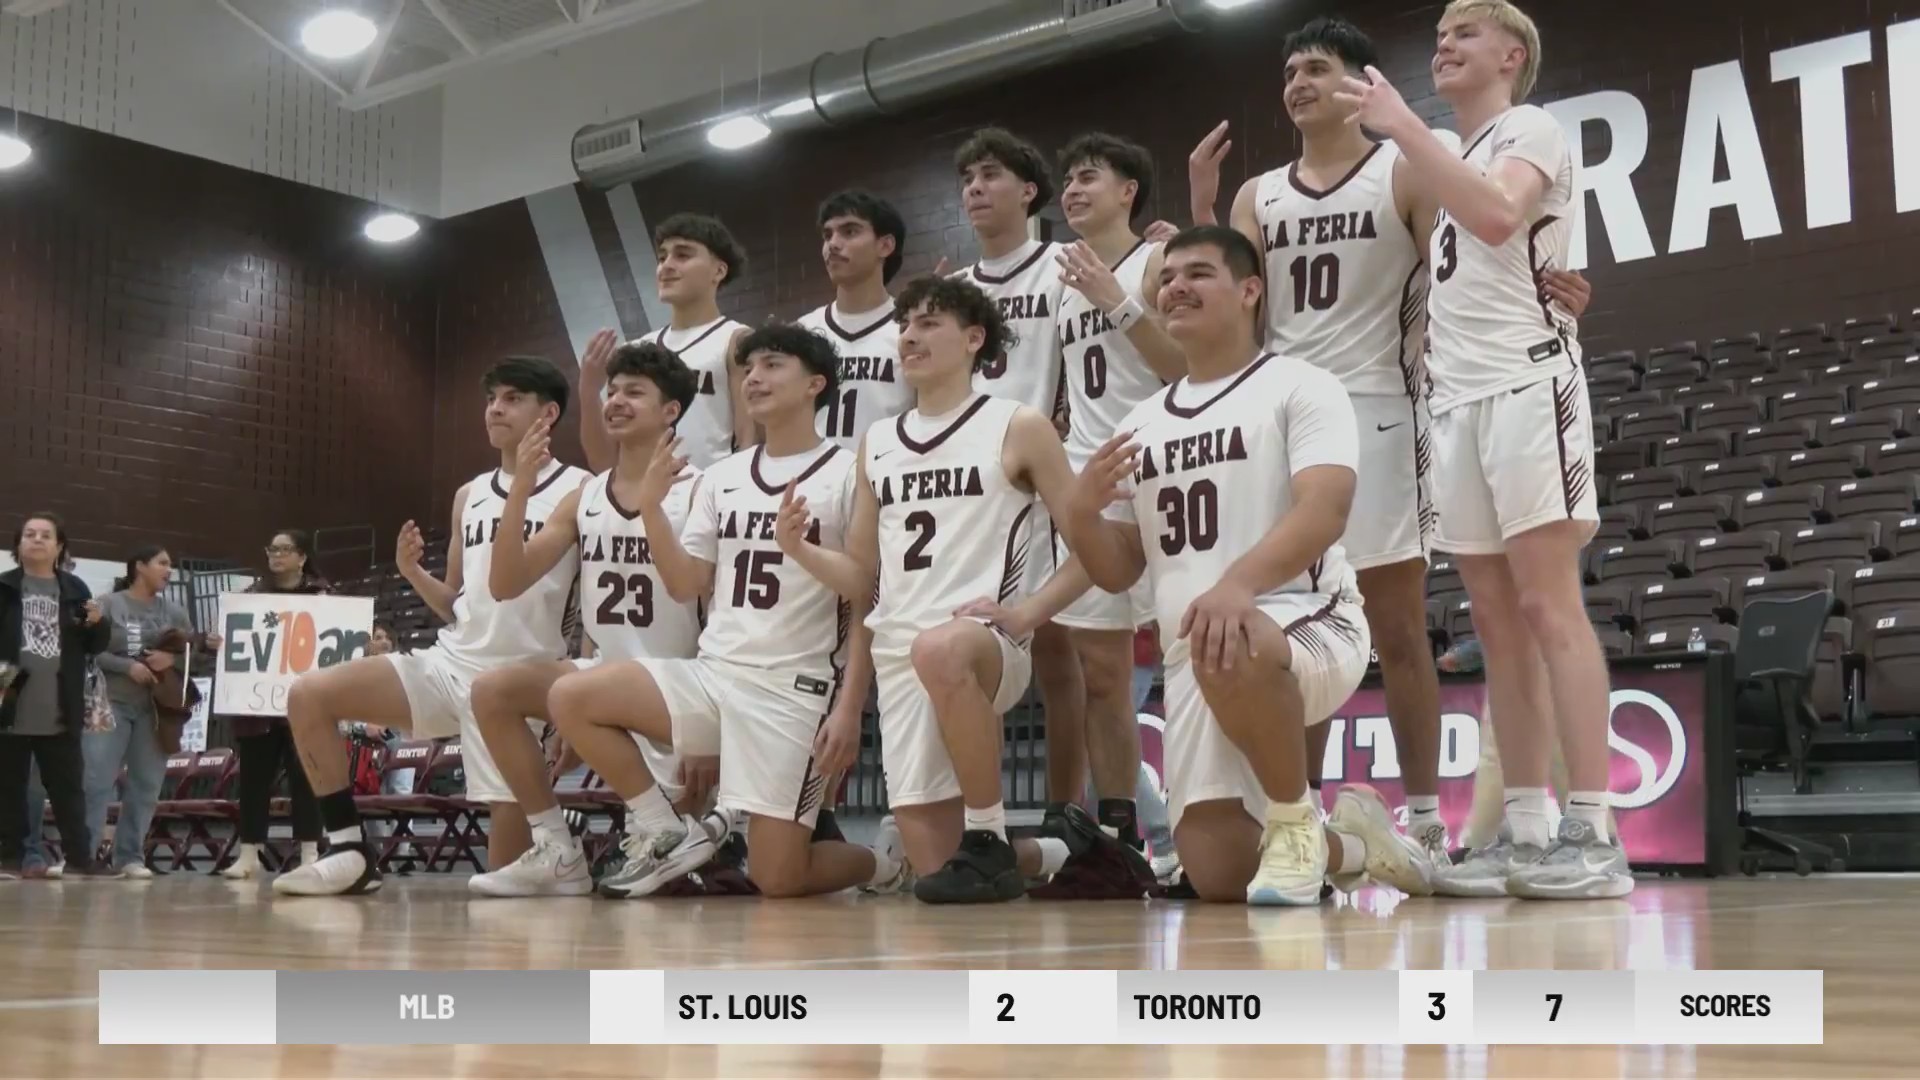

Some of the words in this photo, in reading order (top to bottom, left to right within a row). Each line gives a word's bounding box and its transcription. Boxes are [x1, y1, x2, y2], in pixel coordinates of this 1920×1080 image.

[1262, 220, 1290, 253] LA
[1298, 210, 1377, 246] FERIA
[998, 293, 1050, 322] ERIA
[1290, 252, 1340, 314] 10
[1058, 318, 1076, 348] A
[1084, 344, 1107, 400] 0
[826, 388, 858, 438] 11
[1164, 426, 1247, 475] FERIA
[901, 466, 984, 503] FERIA
[465, 520, 484, 548] LA
[744, 511, 822, 546] FEA
[904, 510, 936, 572] 2
[1157, 478, 1219, 557] 30
[582, 534, 605, 562] LA
[611, 535, 655, 565] FER
[597, 571, 654, 628] 23
[732, 549, 784, 610] 15
